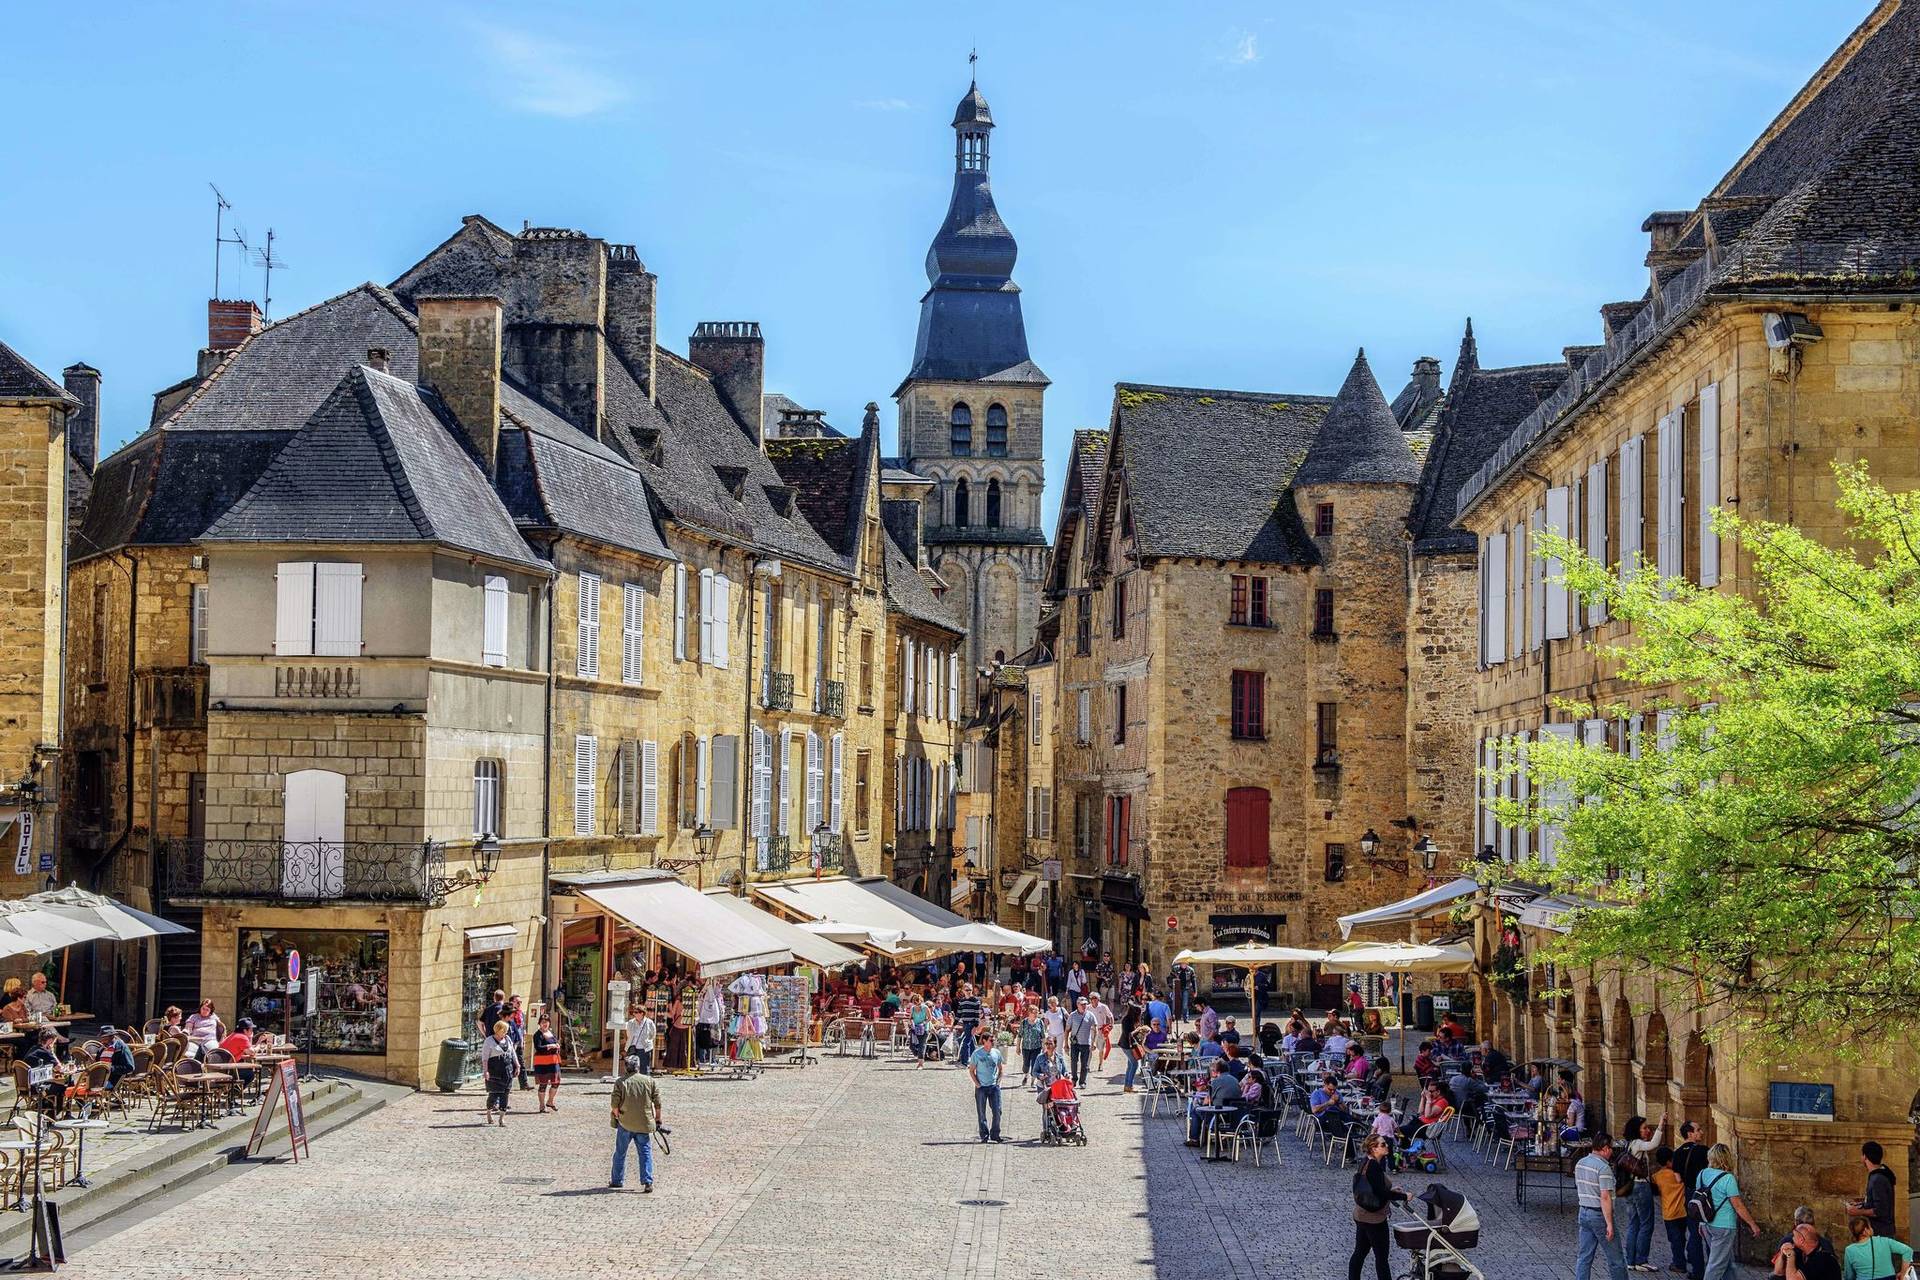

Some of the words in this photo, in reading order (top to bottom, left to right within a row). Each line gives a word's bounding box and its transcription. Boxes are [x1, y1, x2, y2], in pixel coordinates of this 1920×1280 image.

[17, 814, 31, 867] HOTEL
[1238, 892, 1250, 902] DU
[1240, 904, 1264, 913] GRAS
